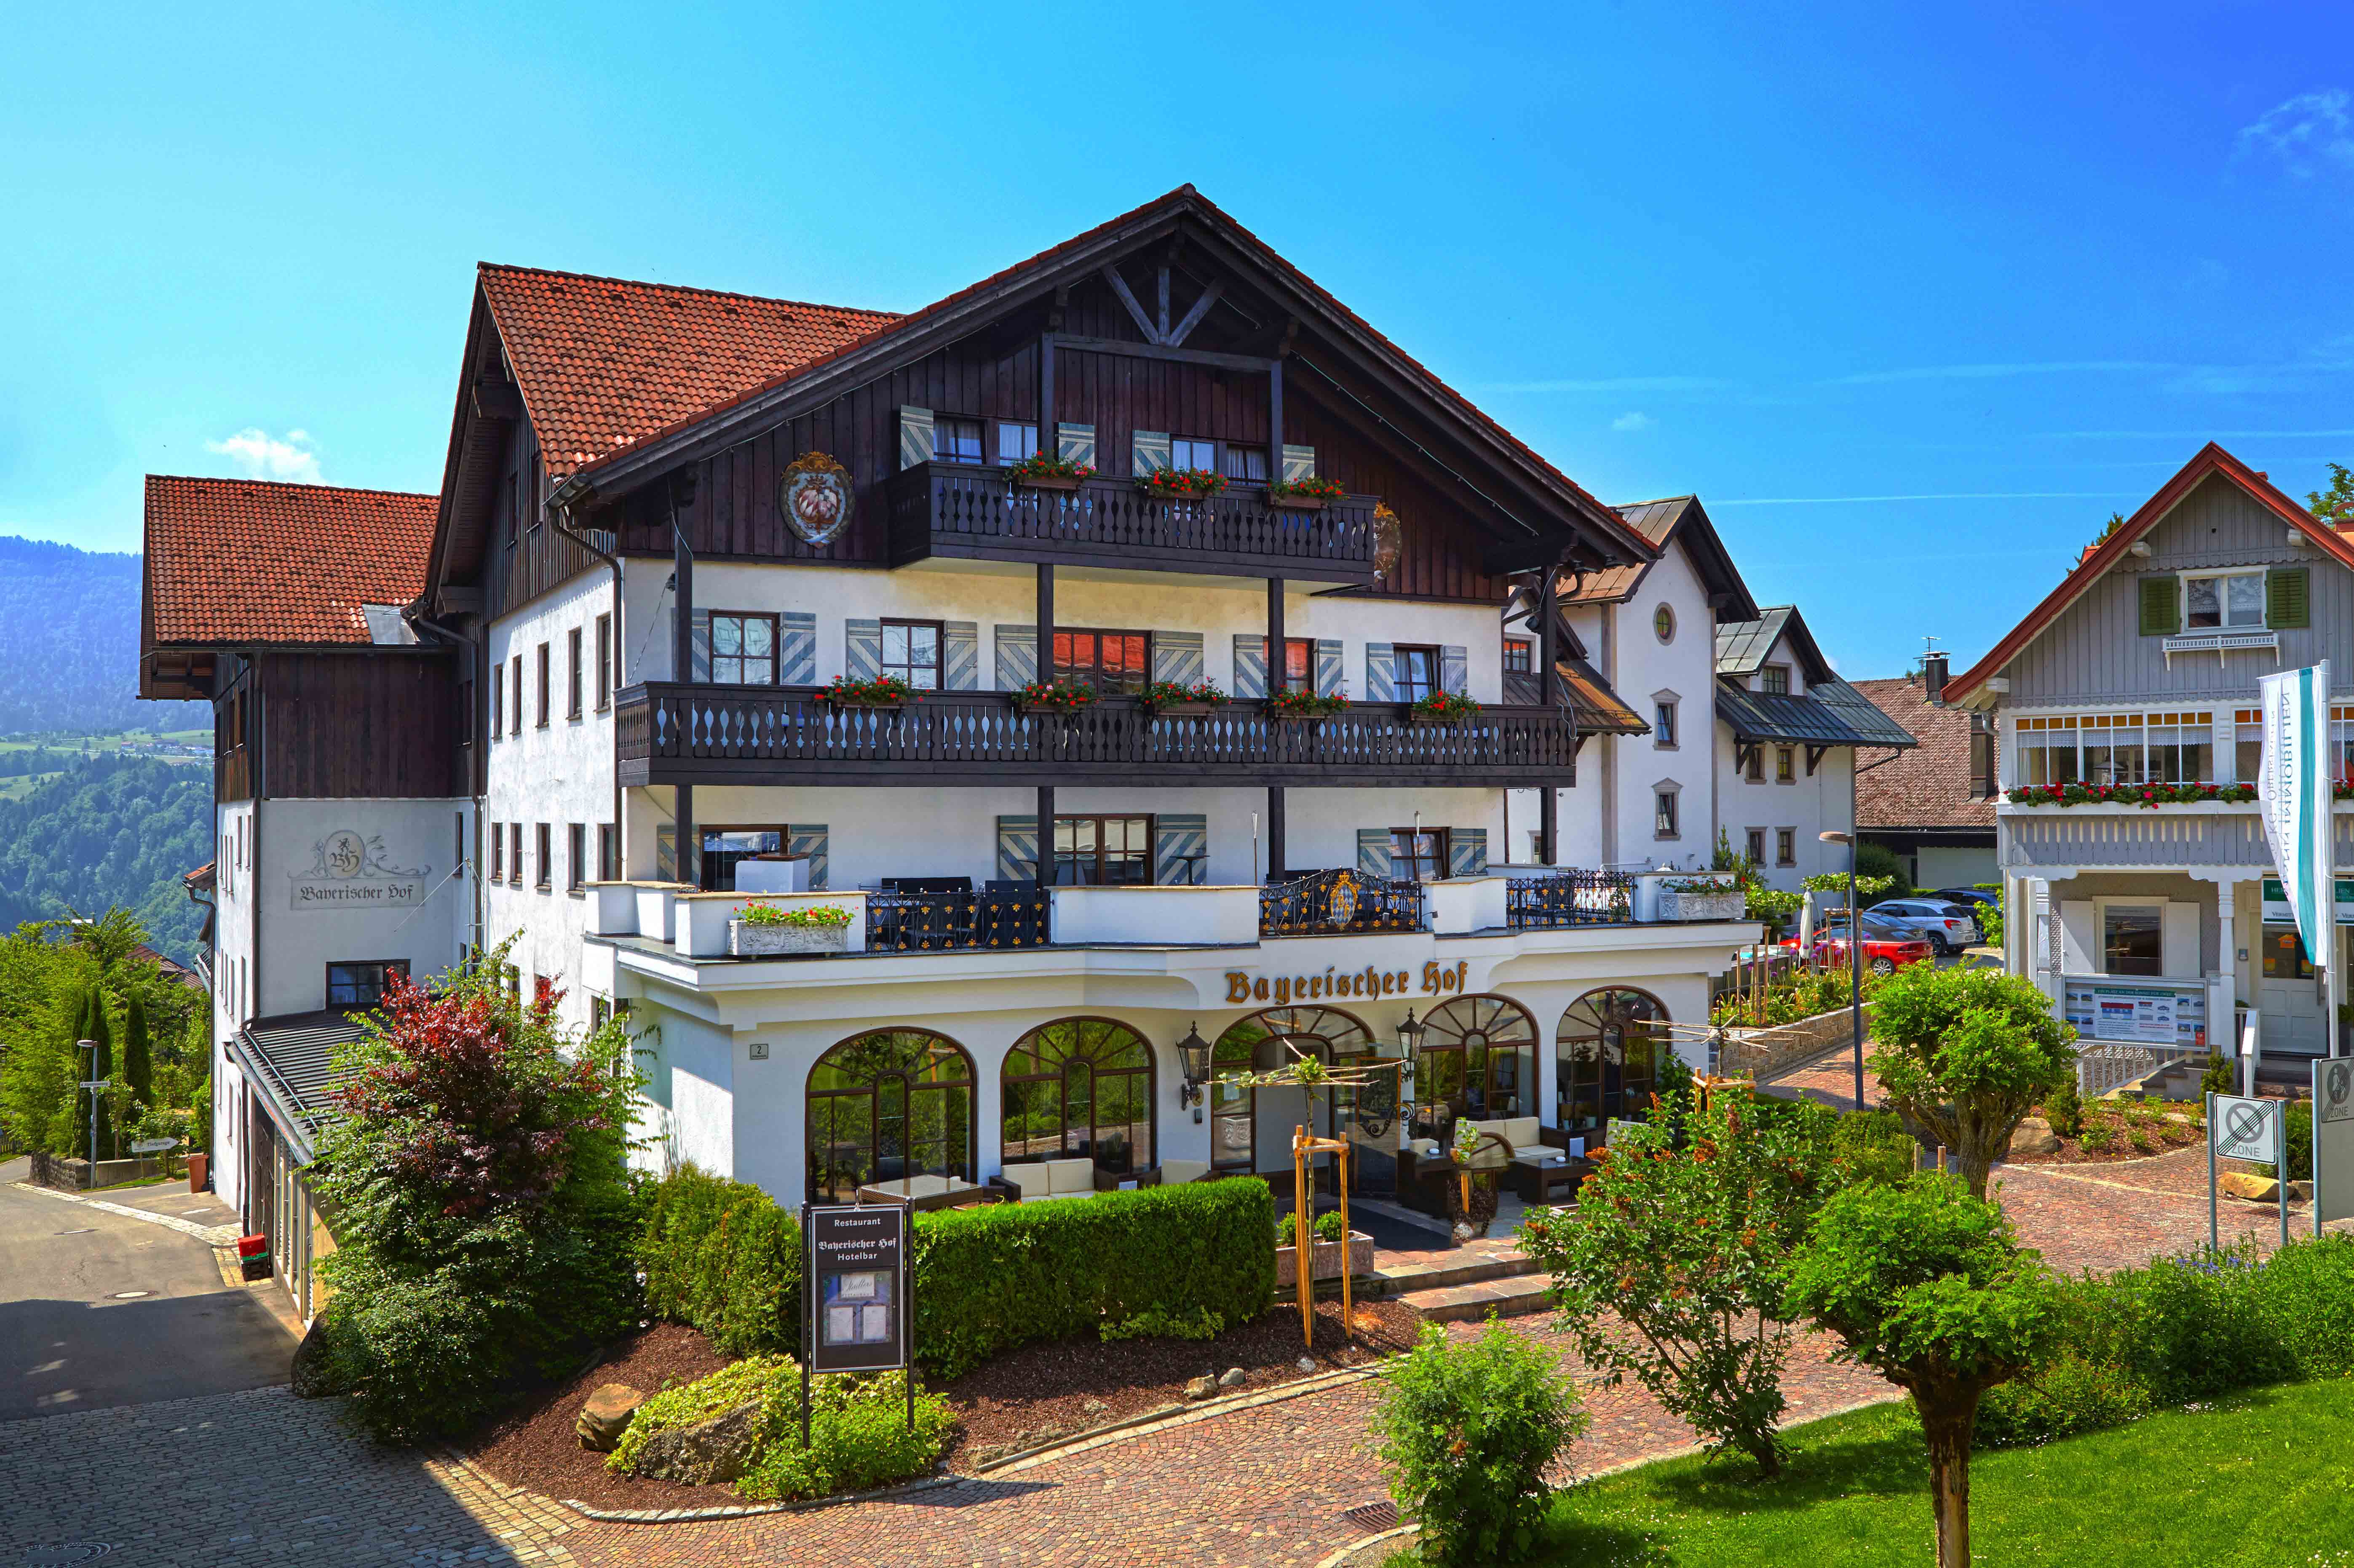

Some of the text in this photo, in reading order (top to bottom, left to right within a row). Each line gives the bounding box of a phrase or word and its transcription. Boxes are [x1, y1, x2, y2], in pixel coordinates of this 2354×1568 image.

[300, 884, 414, 901] Bayerischer Hof
[1225, 961, 1468, 1005] Bayerischer Hof
[757, 1045, 762, 1054] 2
[2330, 1106, 2349, 1118] ZONE
[2231, 1145, 2260, 1157] ZONE
[835, 1218, 881, 1227] Restaurant
[818, 1237, 897, 1251] Bayerischer Hof
[837, 1252, 877, 1261] Hotelbar
